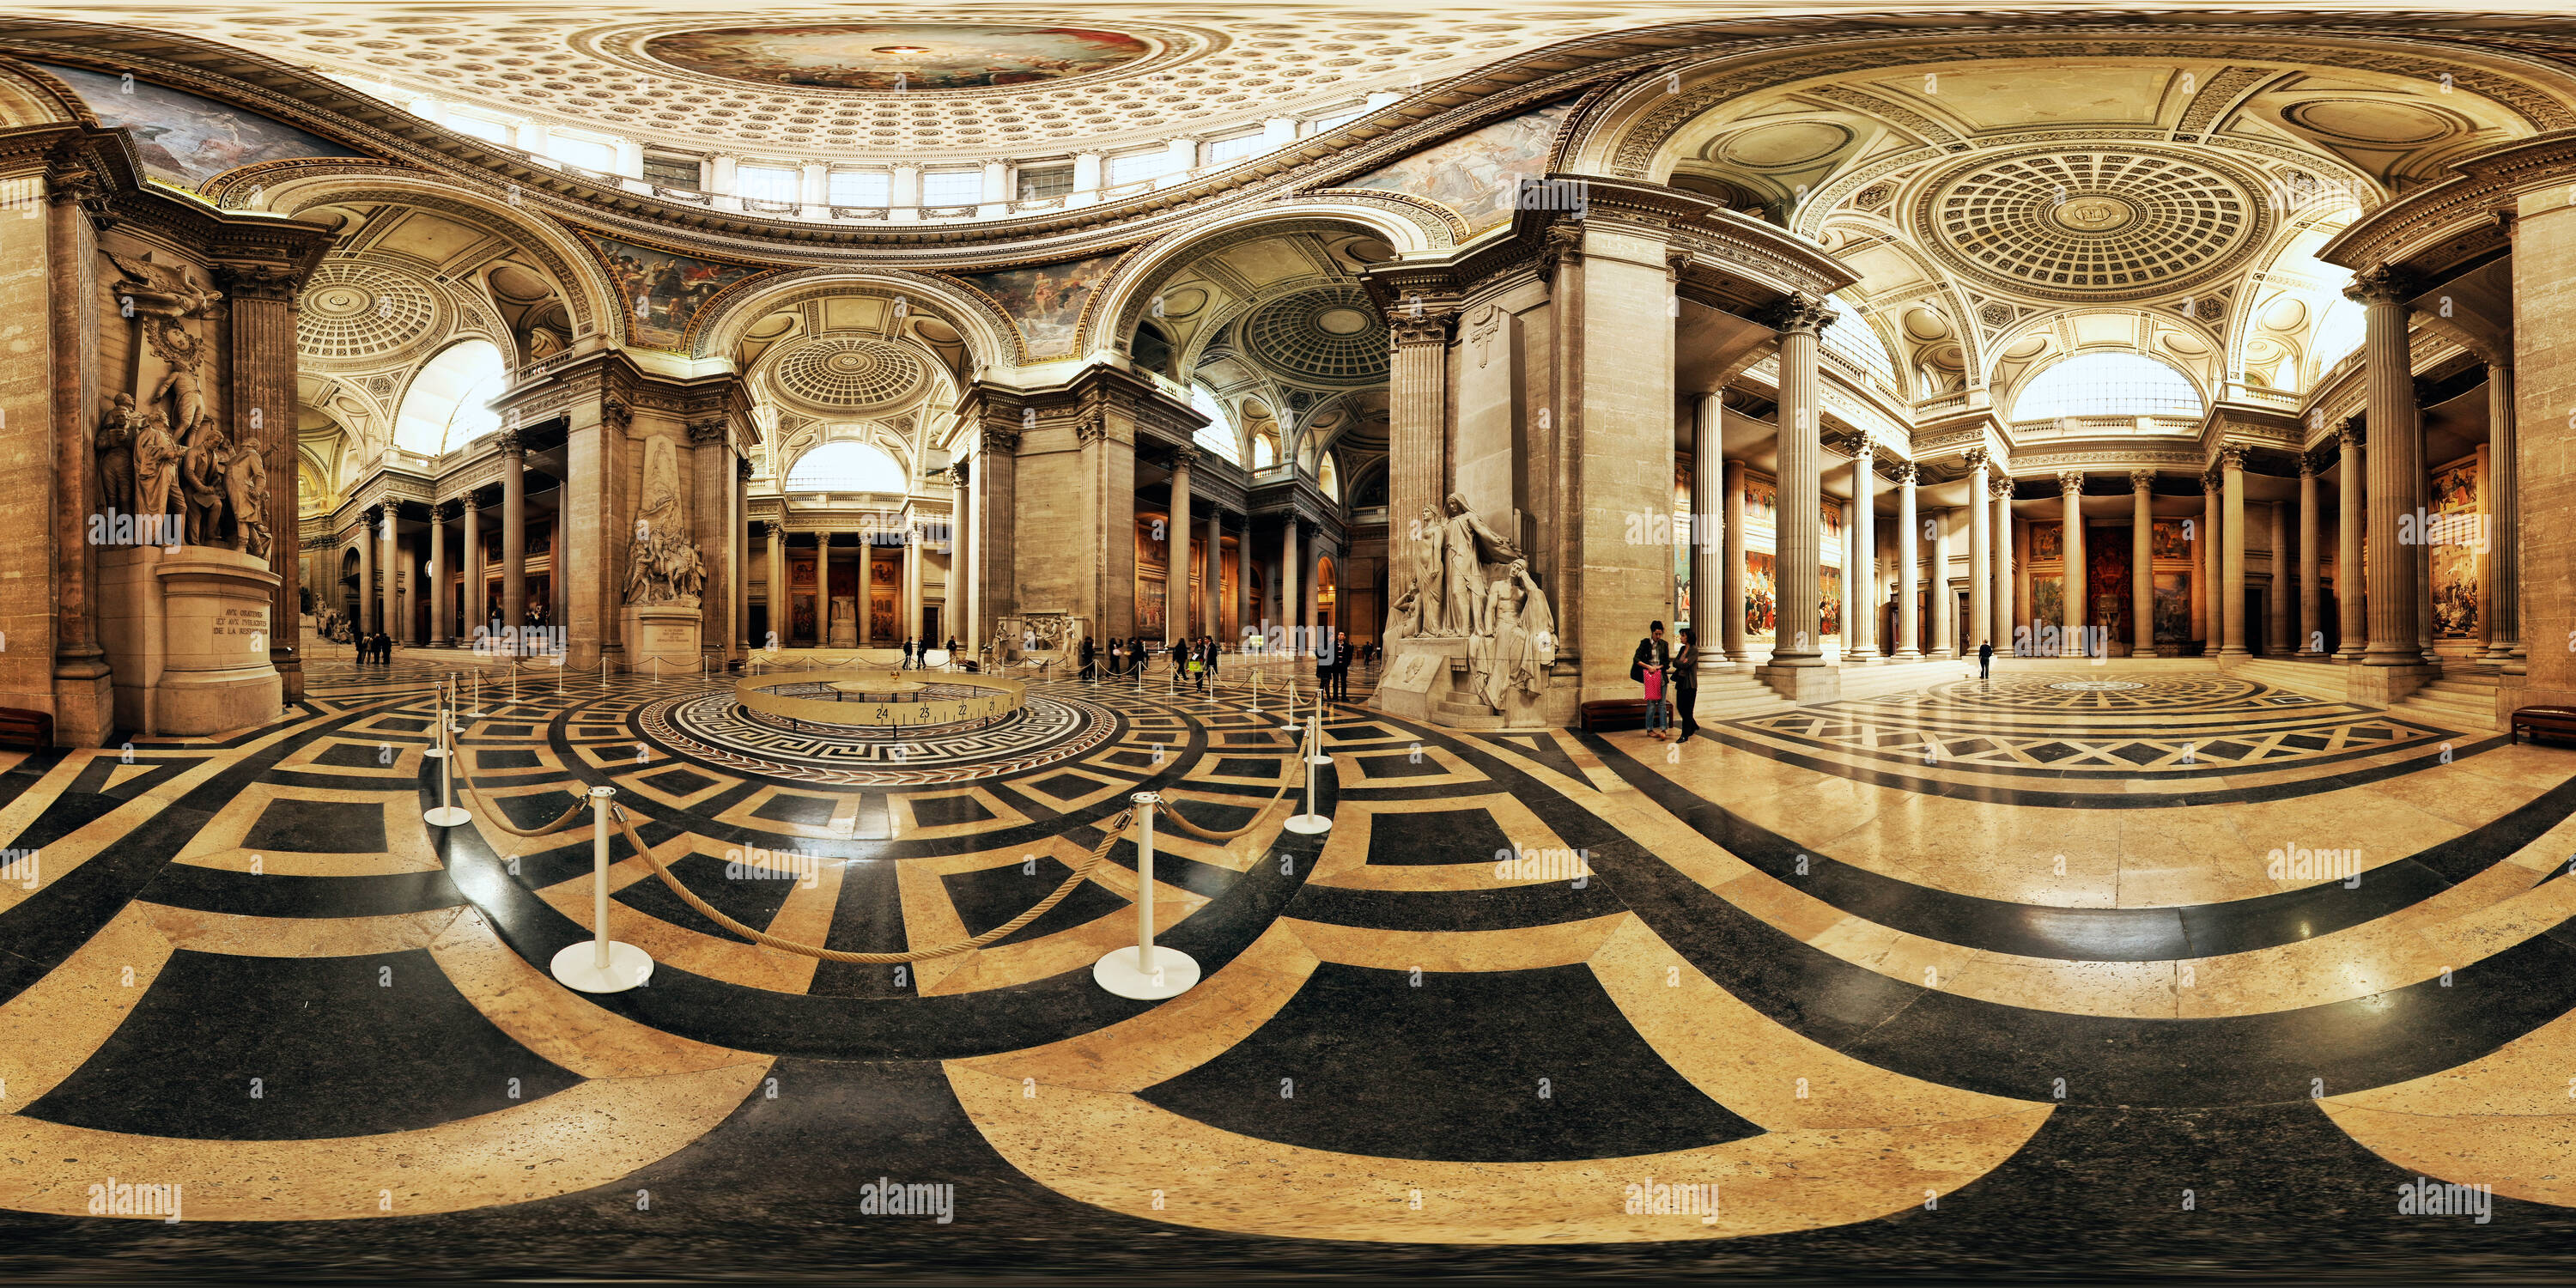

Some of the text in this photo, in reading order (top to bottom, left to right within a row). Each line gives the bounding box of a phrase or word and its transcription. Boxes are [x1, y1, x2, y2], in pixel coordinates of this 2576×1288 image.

[213, 625, 224, 635] DE
[227, 625, 236, 635] LA
[876, 708, 888, 720] 24
[920, 707, 930, 719] 23
[958, 704, 968, 715] 22
[989, 701, 995, 711] 21
